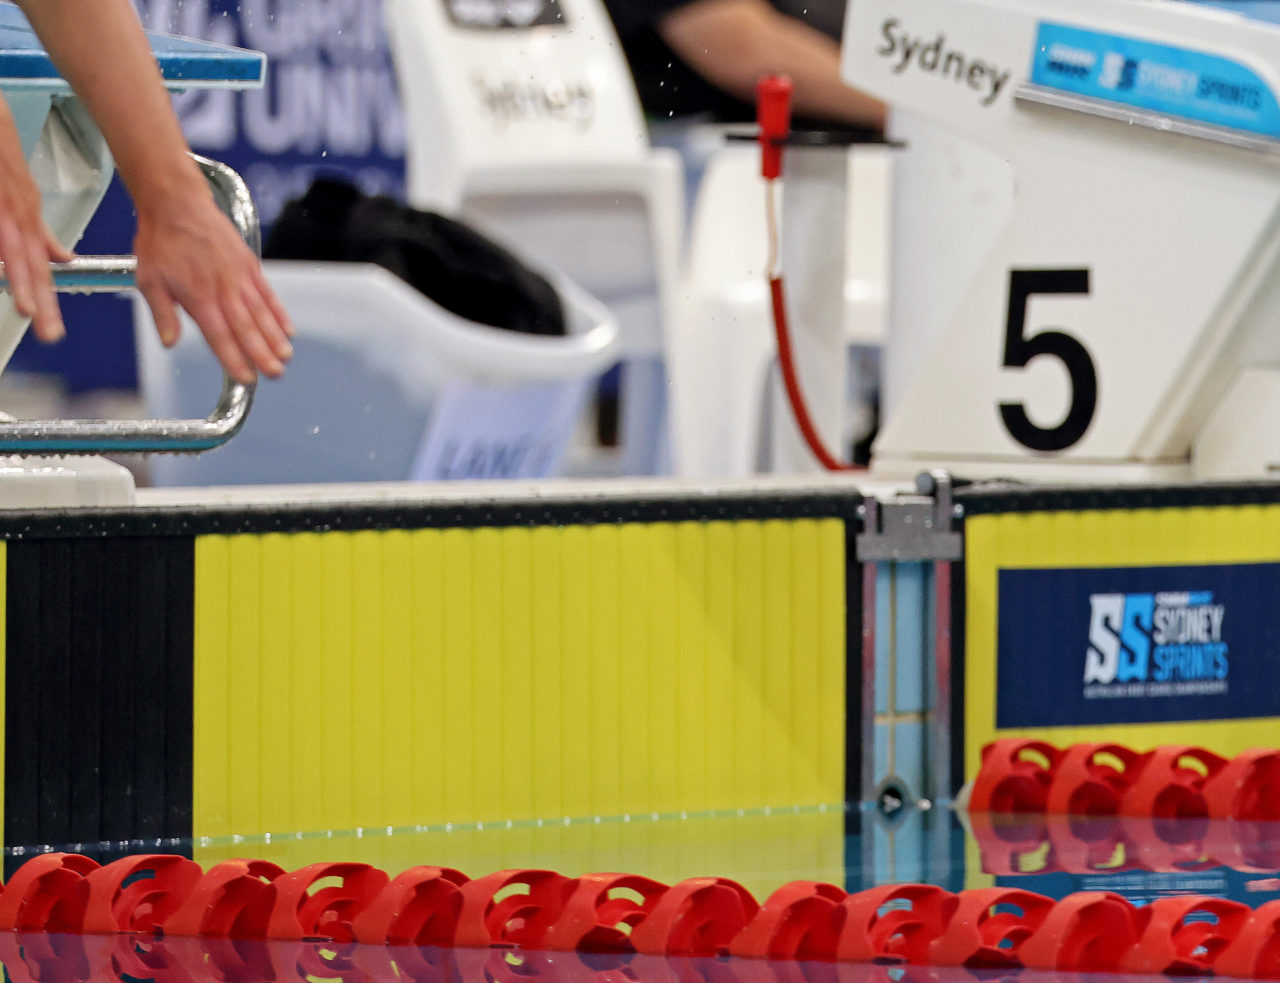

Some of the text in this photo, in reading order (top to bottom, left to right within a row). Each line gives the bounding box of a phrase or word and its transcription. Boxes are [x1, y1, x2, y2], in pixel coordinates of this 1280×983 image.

[877, 17, 1012, 107] Sydney
[998, 268, 1098, 452] 5
[1084, 593, 1153, 683] SS
[1153, 605, 1225, 644] SYDNEY
[1153, 642, 1228, 680] SPRINTS
